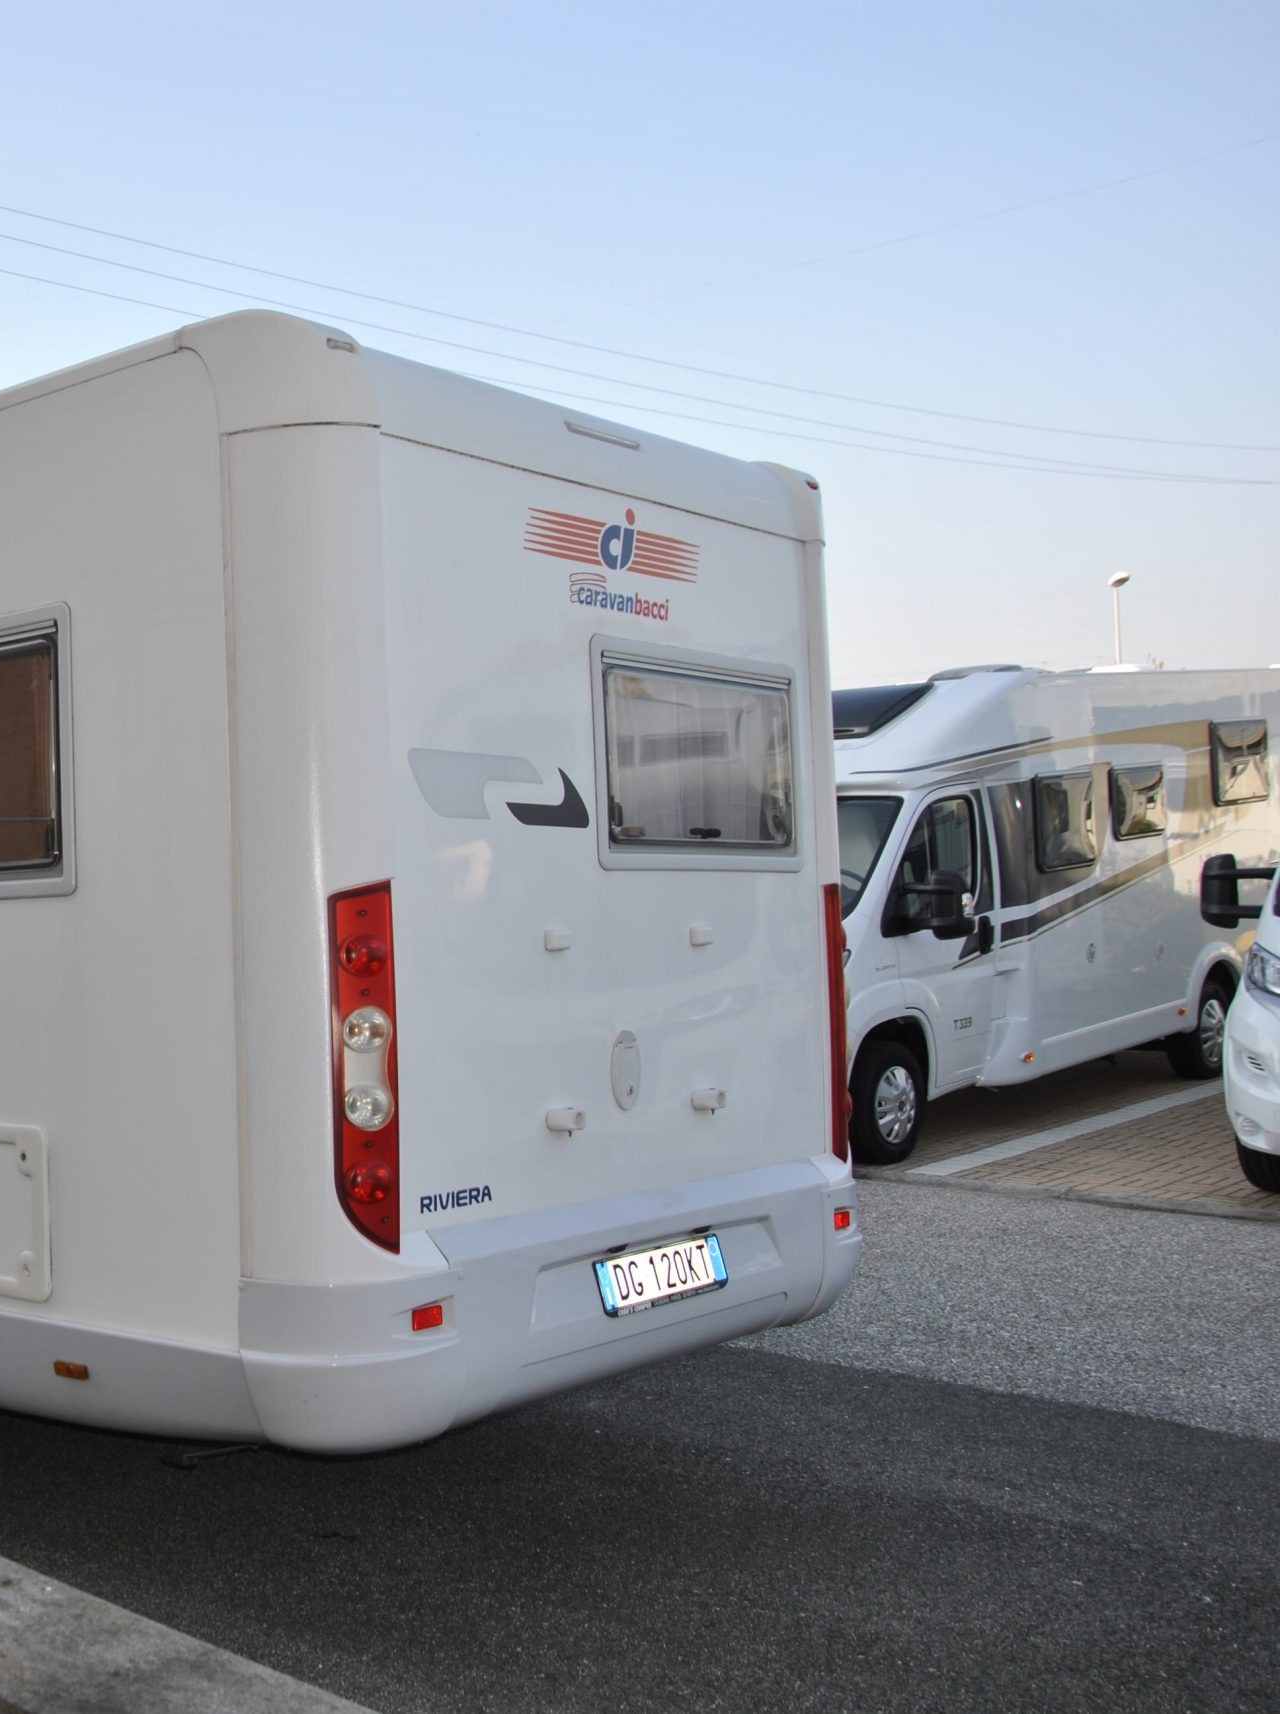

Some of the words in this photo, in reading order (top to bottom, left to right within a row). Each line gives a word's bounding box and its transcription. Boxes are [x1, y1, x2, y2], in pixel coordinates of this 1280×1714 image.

[577, 586, 669, 621] caravanbacci
[420, 1185, 492, 1214] RIVIERA
[613, 1261, 644, 1300] DG
[649, 1244, 709, 1291] 120KT
